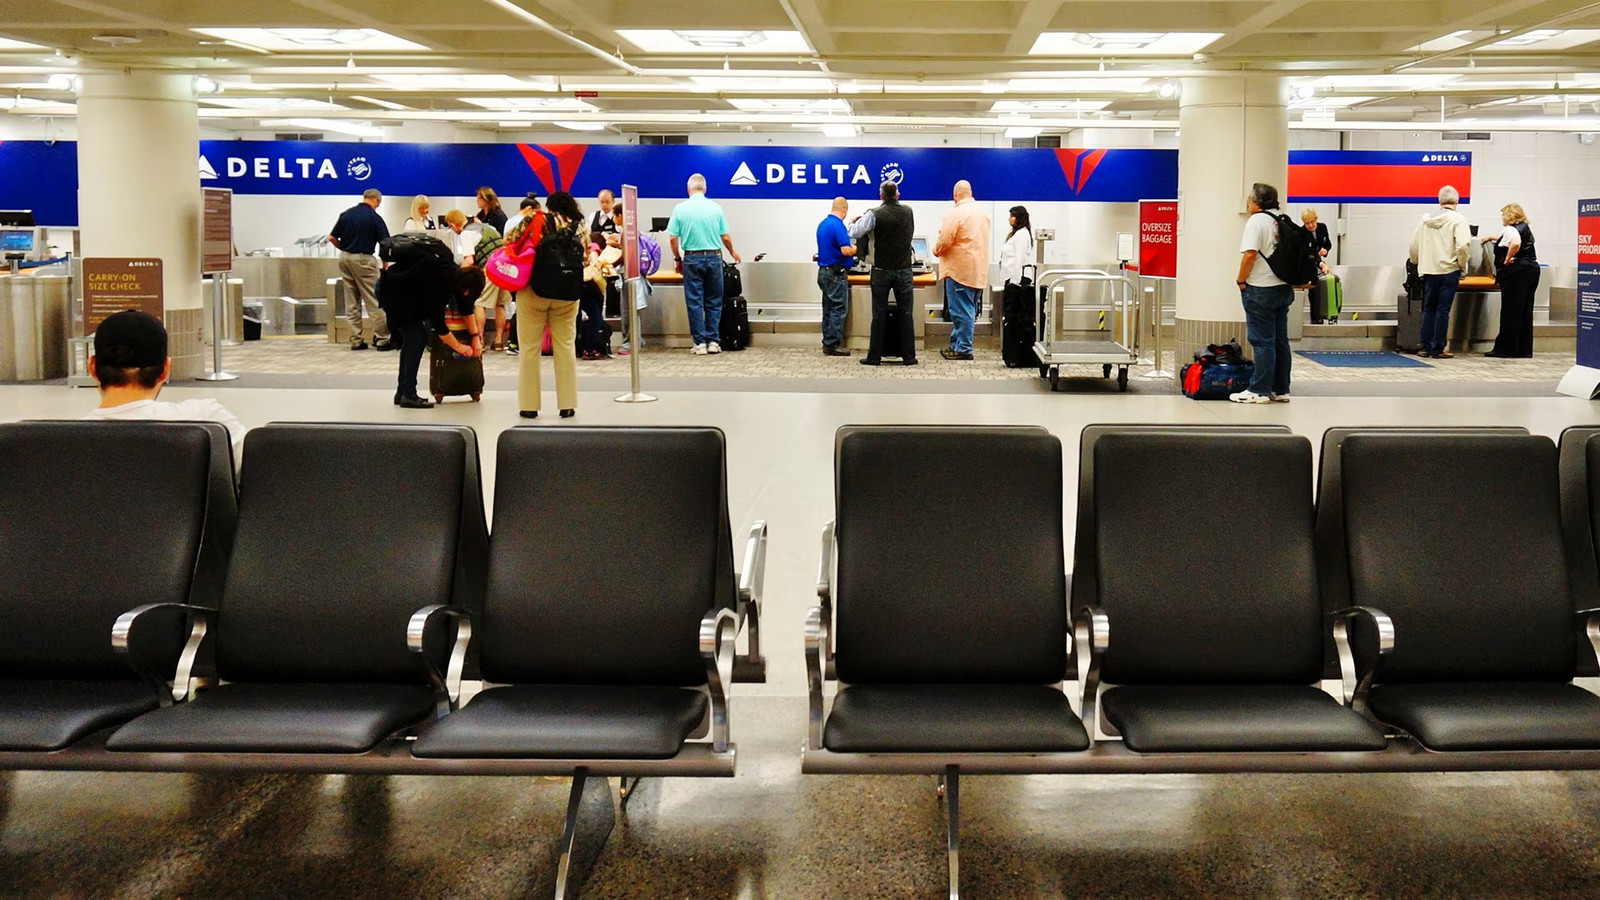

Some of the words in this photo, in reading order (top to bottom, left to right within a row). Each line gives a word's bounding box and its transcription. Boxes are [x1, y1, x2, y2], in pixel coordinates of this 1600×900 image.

[227, 157, 338, 179] DELTA
[766, 163, 871, 184] DELTA
[1142, 222, 1172, 232] OVERSIZE
[1142, 234, 1172, 244] BAGGAGE
[1578, 234, 1592, 244] SKY
[88, 273, 136, 282] CARRY-ON
[89, 282, 108, 291] SIZE
[110, 282, 141, 291] CHECK
